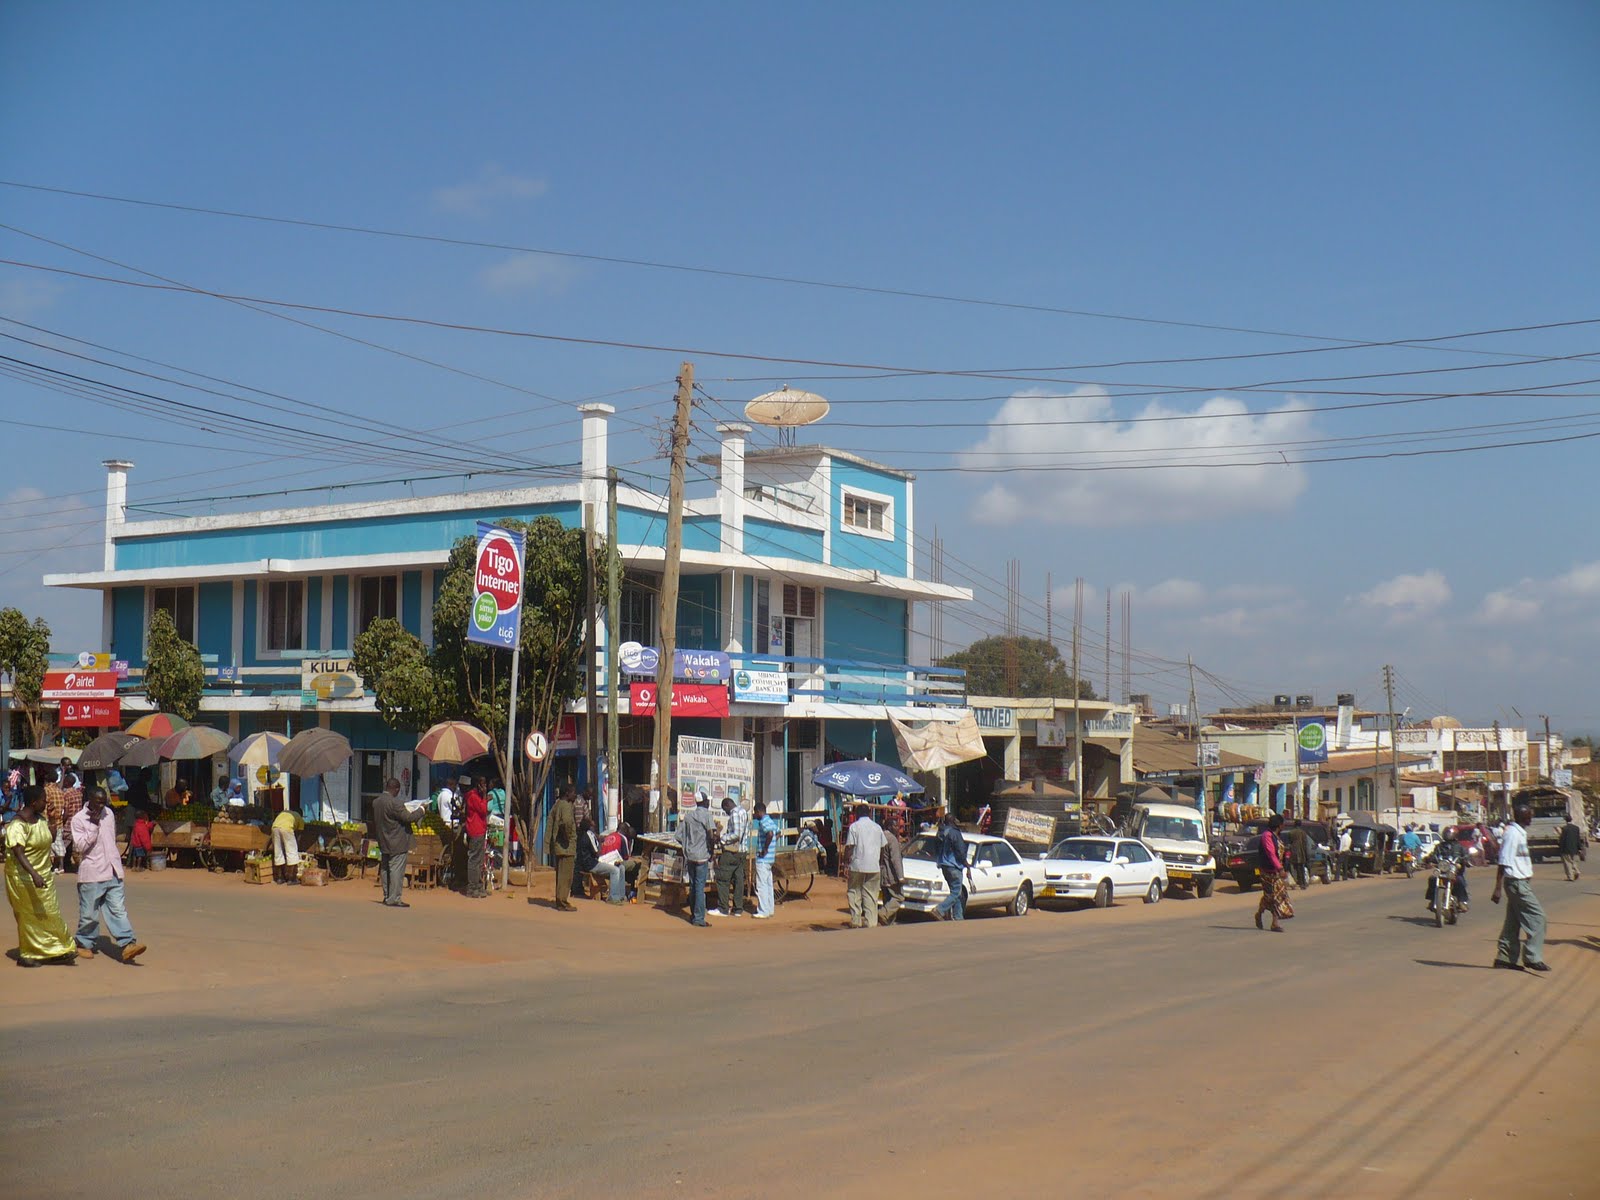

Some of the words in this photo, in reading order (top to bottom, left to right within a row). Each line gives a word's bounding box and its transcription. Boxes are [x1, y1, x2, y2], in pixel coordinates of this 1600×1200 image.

[486, 547, 514, 576] Tigo
[478, 569, 519, 595] Internet
[115, 661, 128, 671] Zap
[683, 655, 720, 667] Wakala
[76, 676, 95, 688] airtel
[682, 695, 708, 704] Wakala
[83, 760, 100, 768] CELLO
[832, 773, 851, 784] tigo
